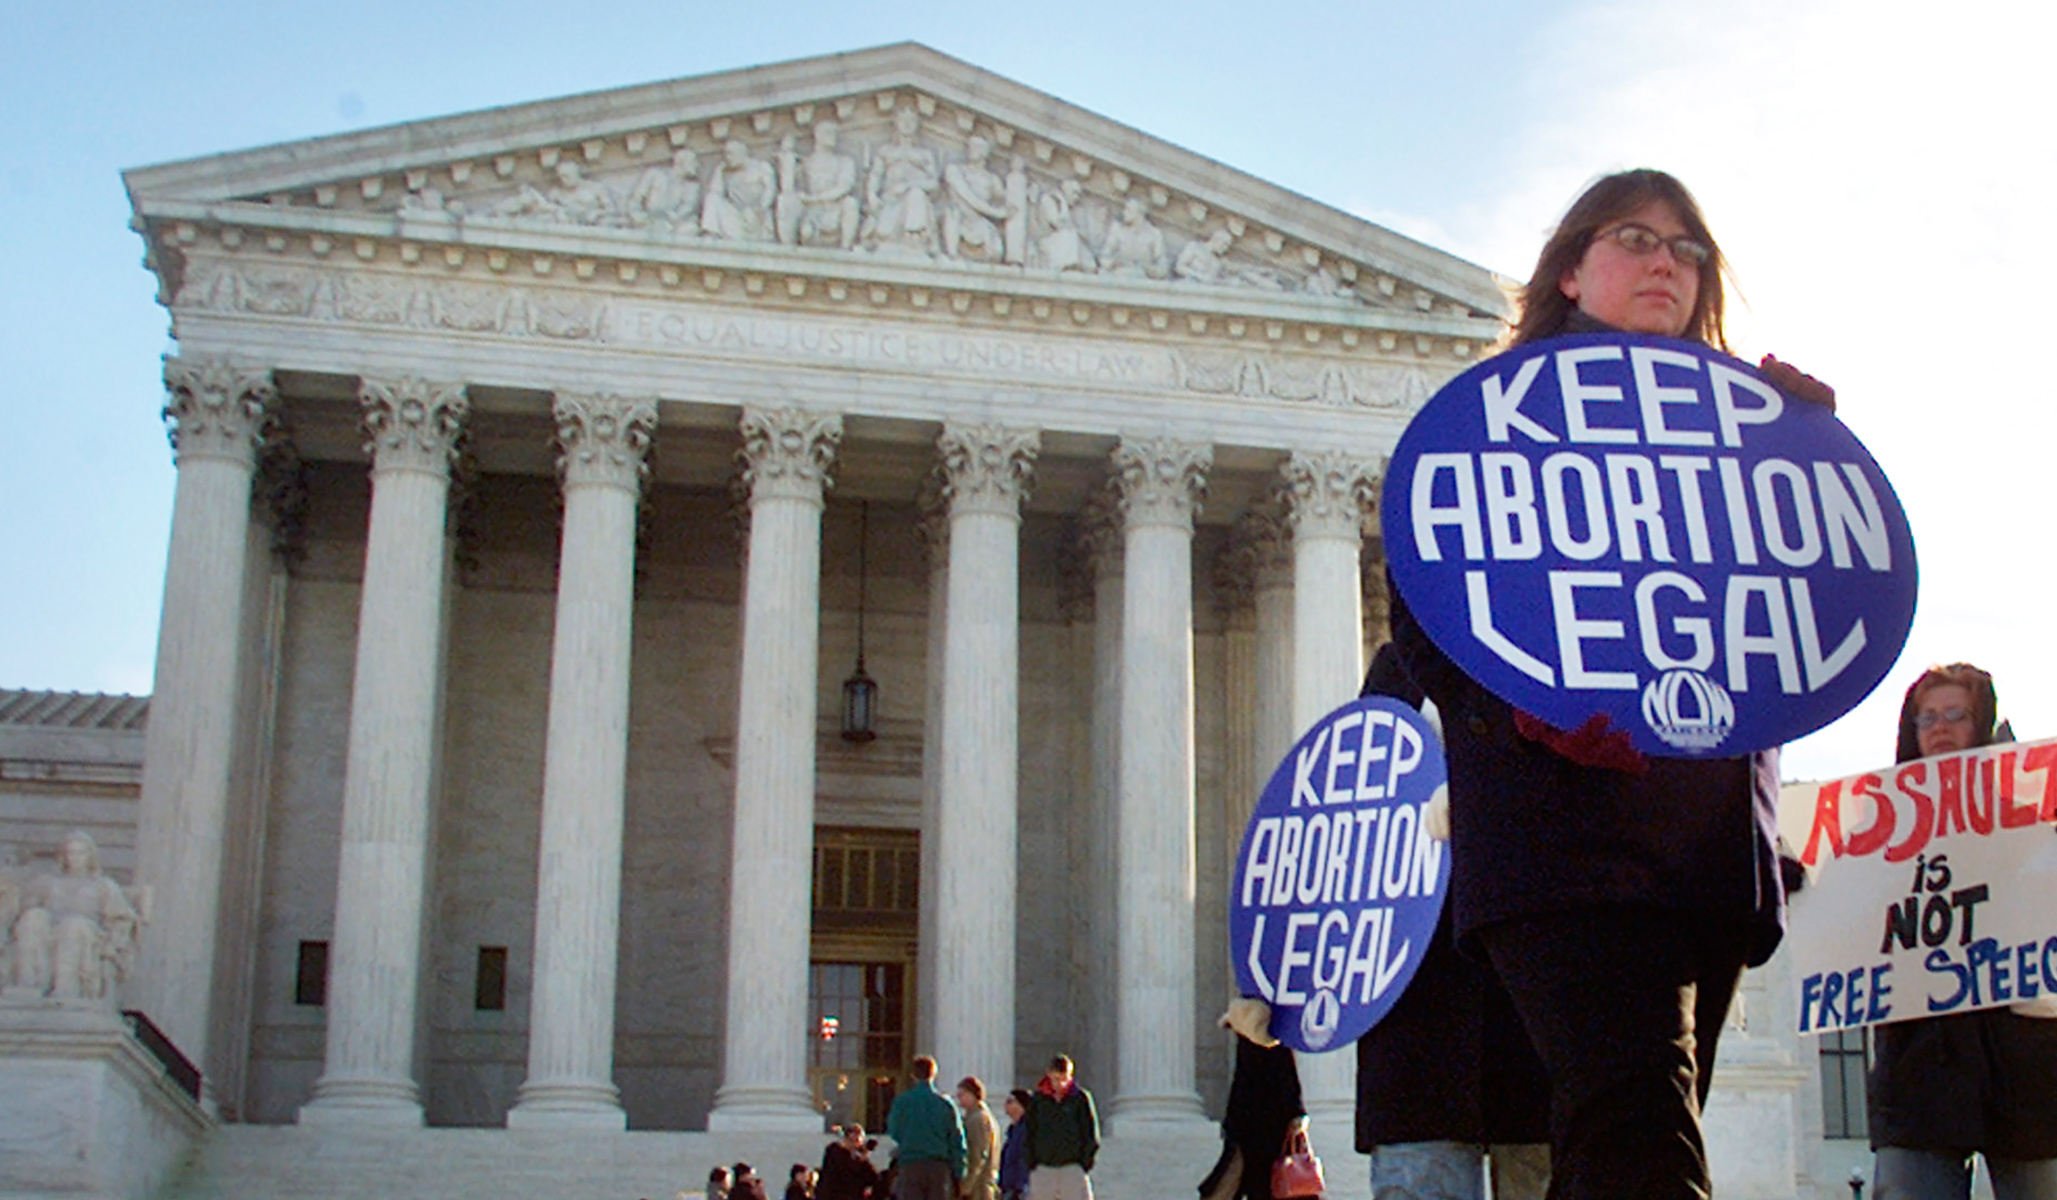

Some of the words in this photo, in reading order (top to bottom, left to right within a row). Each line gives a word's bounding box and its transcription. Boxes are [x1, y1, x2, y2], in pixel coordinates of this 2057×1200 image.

[638, 312, 762, 348] EQUAL
[776, 323, 922, 361] JUSTICE
[939, 339, 1062, 371] UNDER
[1075, 348, 1145, 379] LAW
[1481, 345, 1784, 448] KEEP
[1411, 452, 1892, 572] ABORTION
[1465, 570, 1868, 694] LEGAL
[1291, 710, 1423, 807] KEEP
[1801, 743, 2057, 867] ASSAULT
[1242, 802, 1442, 907] ABORTION
[1249, 907, 1411, 1005] LEGAL
[1881, 883, 1990, 954] NOT
[1799, 962, 1893, 1032] FREE
